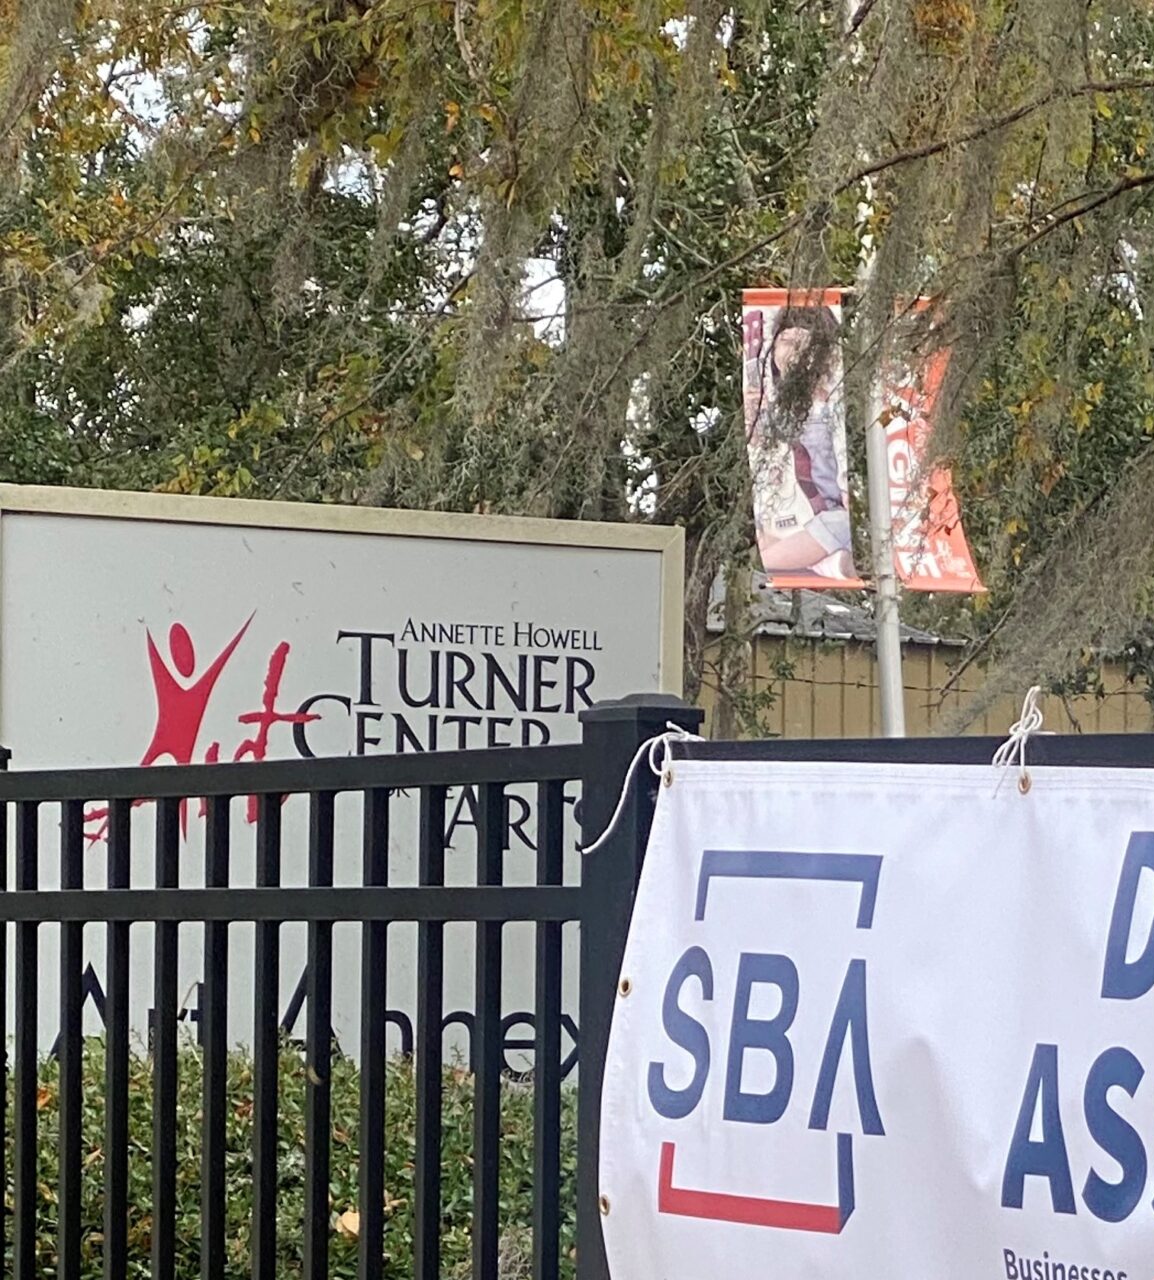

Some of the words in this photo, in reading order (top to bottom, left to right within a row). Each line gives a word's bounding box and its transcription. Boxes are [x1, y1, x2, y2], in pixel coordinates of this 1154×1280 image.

[336, 629, 596, 714] TURNER
[399, 616, 506, 647] ANNETTE
[513, 621, 603, 651] HOWELL
[647, 945, 886, 1137] SBA
